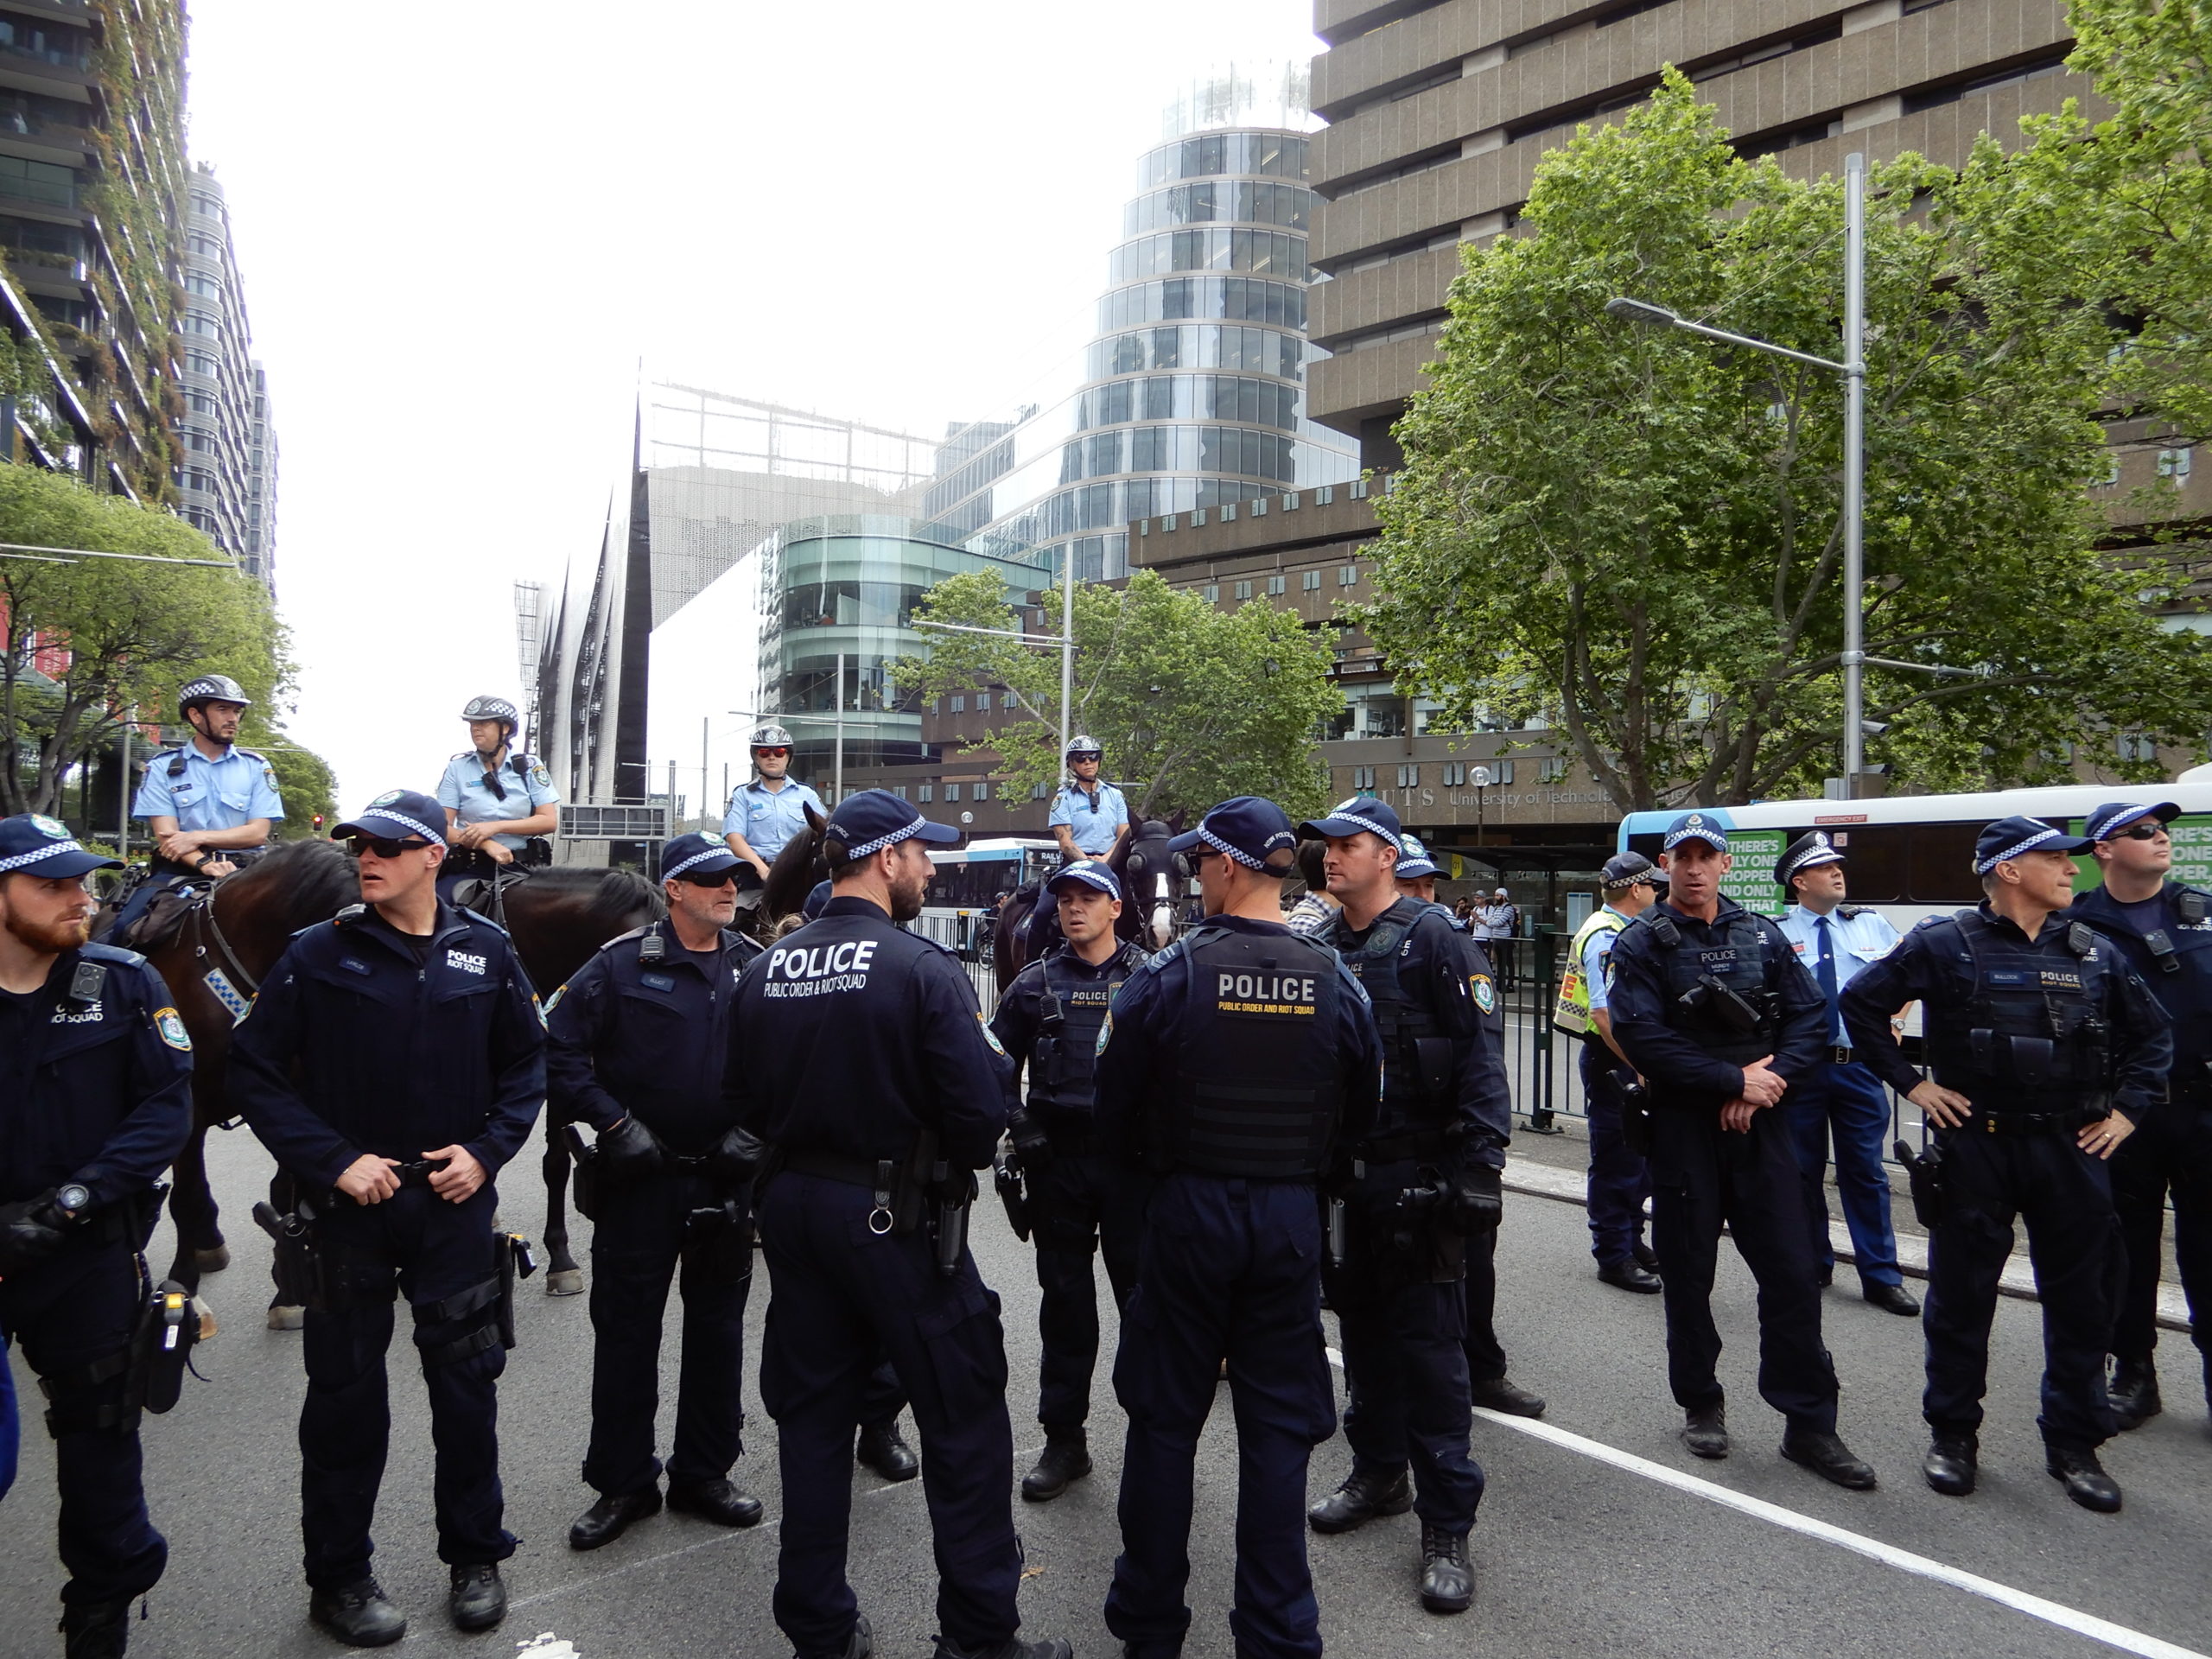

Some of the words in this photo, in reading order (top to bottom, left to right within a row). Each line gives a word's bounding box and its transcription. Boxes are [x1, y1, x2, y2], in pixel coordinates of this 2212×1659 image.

[1382, 788, 1434, 807] UTS
[1449, 791, 1521, 809] University
[1526, 789, 1542, 804] of
[1545, 788, 1613, 804] Technolo
[2168, 826, 2212, 842] RE'S
[1729, 839, 1779, 853] THERE'S
[1751, 855, 1779, 868] ONE
[1743, 884, 1778, 897] ONLY
[1743, 899, 1778, 912] THAT
[447, 950, 487, 967] POLICE
[766, 940, 879, 979] POLICE
[1700, 950, 1737, 963] POLICE
[447, 958, 464, 970] RIOT
[1347, 963, 1363, 972] LICE
[2040, 971, 2081, 983] POLICE
[764, 982, 790, 998] PUBLIC
[789, 981, 813, 997] ORDER
[814, 980, 820, 995] &
[821, 976, 838, 994] RIOT
[836, 974, 867, 992] SQUAD
[1218, 973, 1315, 1001] POLICE
[1072, 991, 1108, 1001] POLICE
[1218, 1001, 1242, 1011] PUBLIC
[1242, 1002, 1262, 1013] ORDER
[1264, 1004, 1277, 1014] AND
[1278, 1004, 1293, 1014] RIOT
[1294, 1005, 1315, 1015] SQUAD
[51, 1014, 67, 1023] IOT
[67, 1012, 104, 1023] SQUAD
